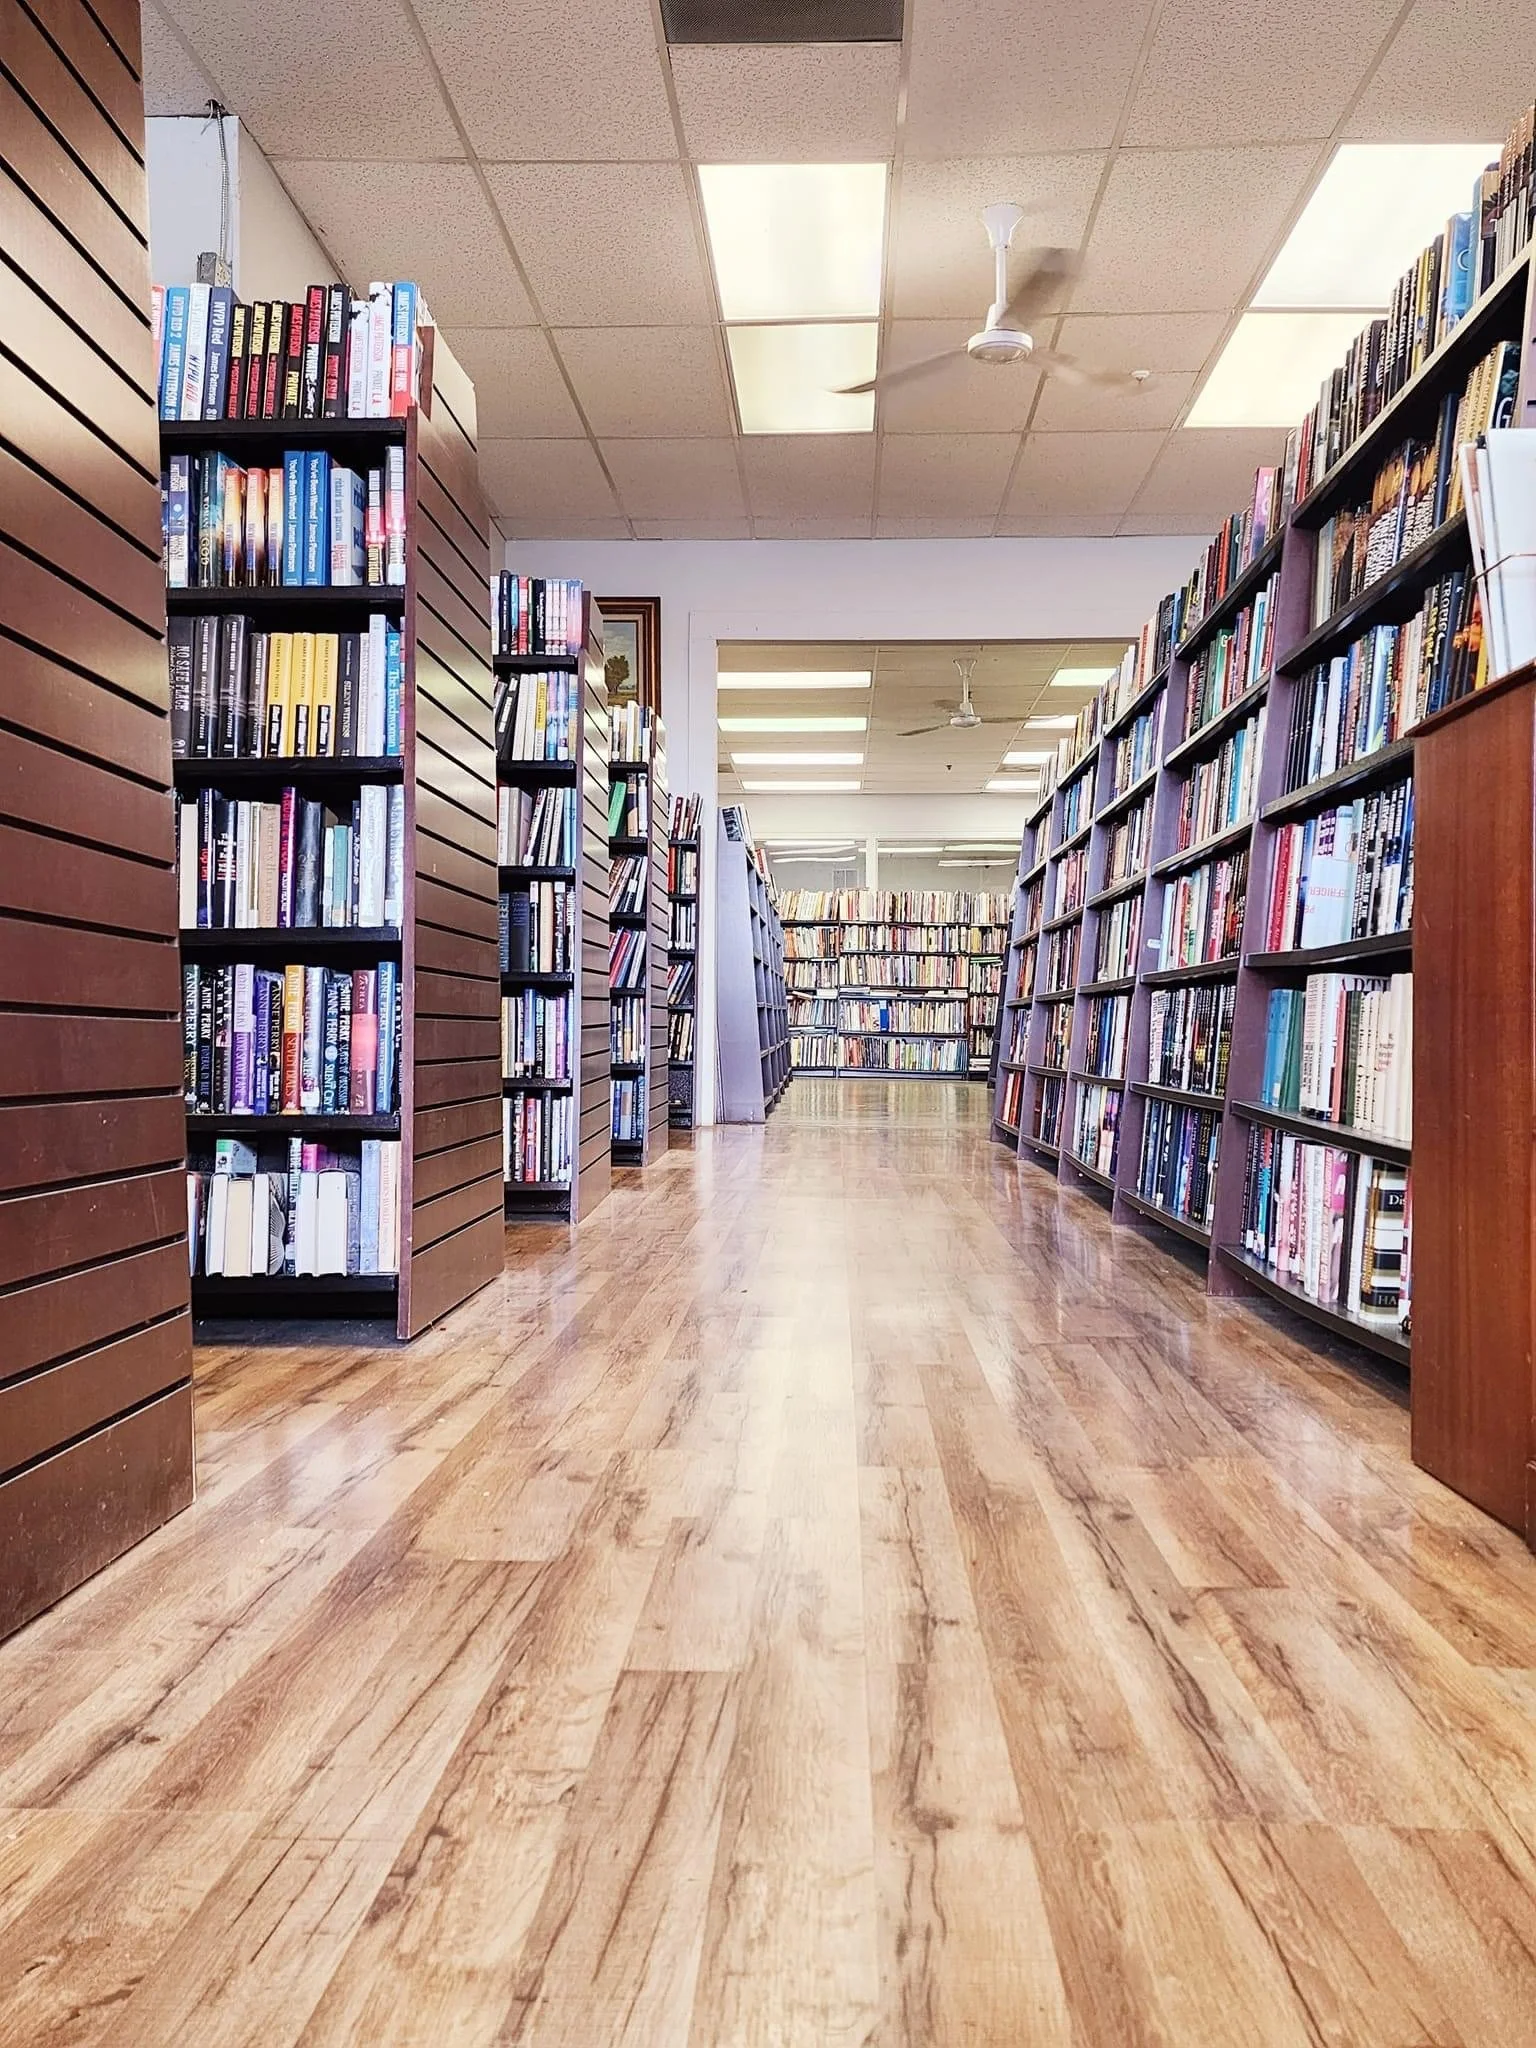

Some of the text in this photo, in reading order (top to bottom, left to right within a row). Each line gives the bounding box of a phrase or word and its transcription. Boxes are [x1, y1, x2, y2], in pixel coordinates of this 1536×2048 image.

[305, 288, 322, 379] JAMES PATTERSON PRIVATE
[188, 354, 200, 382] NYPD
[208, 301, 226, 406] NYPD Red James Patterson
[164, 343, 182, 407] JAMES PATTERSON
[230, 366, 239, 395] POSTCARD
[250, 363, 260, 392] POSTCARD
[286, 371, 299, 406] PRIVATE
[228, 395, 237, 418] KILLERS
[248, 393, 258, 416] KILLERS
[288, 459, 299, 572] You've Been Warned James Patterson
[309, 459, 319, 572] You've Been Warned James Patterson
[1438, 578, 1452, 632] TROPIC
[175, 645, 190, 712] NO SAFE PLACE
[343, 680, 352, 706] SILENT
[342, 706, 351, 738] WITNESS
[201, 986, 212, 1009] ANNE
[224, 974, 232, 1021] ANNE
[340, 988, 350, 1012] ANNE
[359, 975, 368, 1009] TATHEA
[380, 969, 388, 999] ANNE
[186, 972, 198, 1046] ANNE PERRY
[201, 1013, 211, 1039] PERRY
[258, 988, 268, 1050] ANNE PERRY
[271, 985, 280, 1051] ANNE PERRY
[380, 1001, 388, 1031] PERRY
[285, 971, 299, 1099] ANNE PERRY SEVEN DIALS
[339, 1015, 350, 1042] PERRY
[324, 988, 337, 1106] ANNE PERRY SILENT CRY
[1320, 1264, 1328, 1285] GIRL
